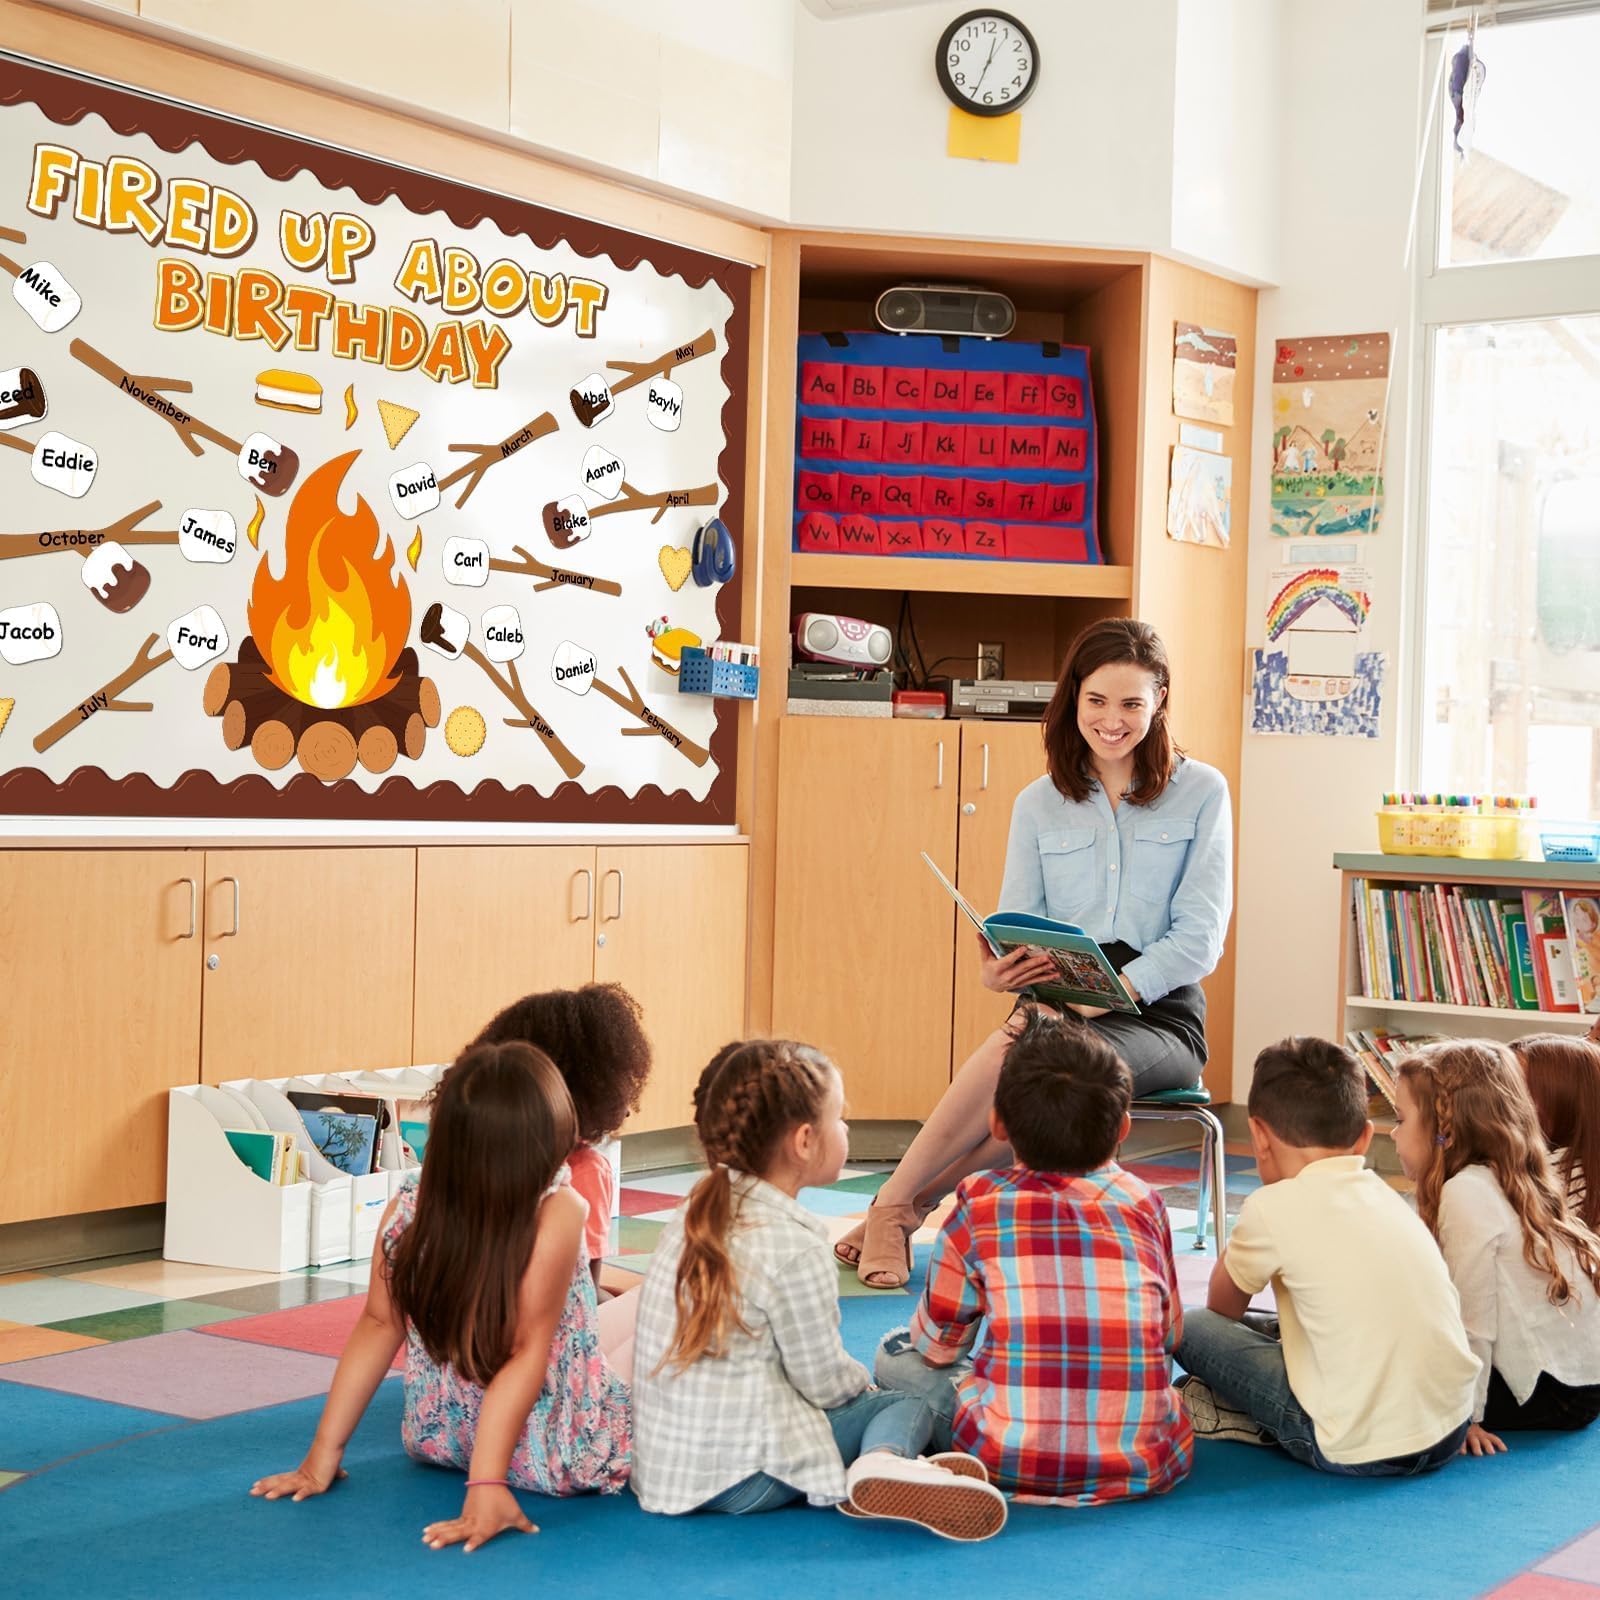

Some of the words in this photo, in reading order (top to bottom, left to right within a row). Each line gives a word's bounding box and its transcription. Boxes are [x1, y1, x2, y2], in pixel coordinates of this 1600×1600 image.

[966, 26, 979, 38] 11
[981, 21, 997, 34] 12
[1003, 28, 1008, 39] 1
[955, 40, 970, 51] 10
[1013, 40, 1022, 52] 2
[949, 54, 960, 67] 9
[1017, 58, 1027, 70] 3
[955, 72, 965, 85] 8
[1011, 75, 1021, 87] 4
[969, 87, 977, 99] 7
[983, 91, 993, 104] 6
[1000, 88, 1010, 99] 5
[26, 142, 258, 259] FIRED
[279, 209, 375, 284] UP
[394, 238, 609, 339] ABOUT
[20, 267, 61, 309] Mike
[153, 257, 513, 390] BIRTHDAY
[674, 343, 696, 362] May
[0, 381, 35, 404] eed
[119, 375, 191, 426] November
[581, 388, 609, 407] Abel
[810, 375, 835, 393] Aa
[853, 378, 876, 396] Bb
[896, 381, 919, 398] Cc
[934, 382, 958, 400] Dd
[975, 384, 994, 400] Ee
[1021, 386, 1039, 404] Ff
[1051, 385, 1076, 408] Gg
[649, 389, 681, 417] Bayly
[500, 428, 534, 458] March
[811, 431, 835, 448] Hh
[857, 433, 871, 449] Ii
[897, 433, 912, 453] Jj
[936, 437, 955, 453] Kk
[979, 438, 994, 455] Ll
[1010, 440, 1040, 456] Mm
[1056, 440, 1079, 457] Nn
[41, 448, 94, 473] Eddie
[247, 450, 279, 475] Ben
[585, 459, 621, 484] Aaron
[396, 473, 438, 499] David
[665, 492, 690, 506] April
[805, 484, 832, 501] Oo
[851, 486, 872, 505] Pp
[884, 486, 913, 507] Qq
[935, 490, 953, 507] Rr
[976, 492, 994, 508] Ss
[1019, 495, 1034, 511] Tt
[1053, 497, 1072, 512] Uu
[553, 514, 588, 532] Blake
[38, 530, 105, 548] October
[182, 517, 235, 554] James
[809, 524, 829, 541] Vv
[843, 526, 874, 543] Ww
[888, 531, 911, 545] Xx
[931, 528, 952, 545] Yy
[975, 531, 995, 547] Zz
[454, 552, 482, 567] Carl
[551, 569, 595, 589] January
[0, 621, 55, 640] Jacob
[177, 627, 218, 651] Ford
[486, 627, 523, 645] Caleb
[555, 658, 595, 681] Daniel
[78, 690, 109, 721] July
[529, 715, 555, 739] June
[641, 706, 682, 749] February
